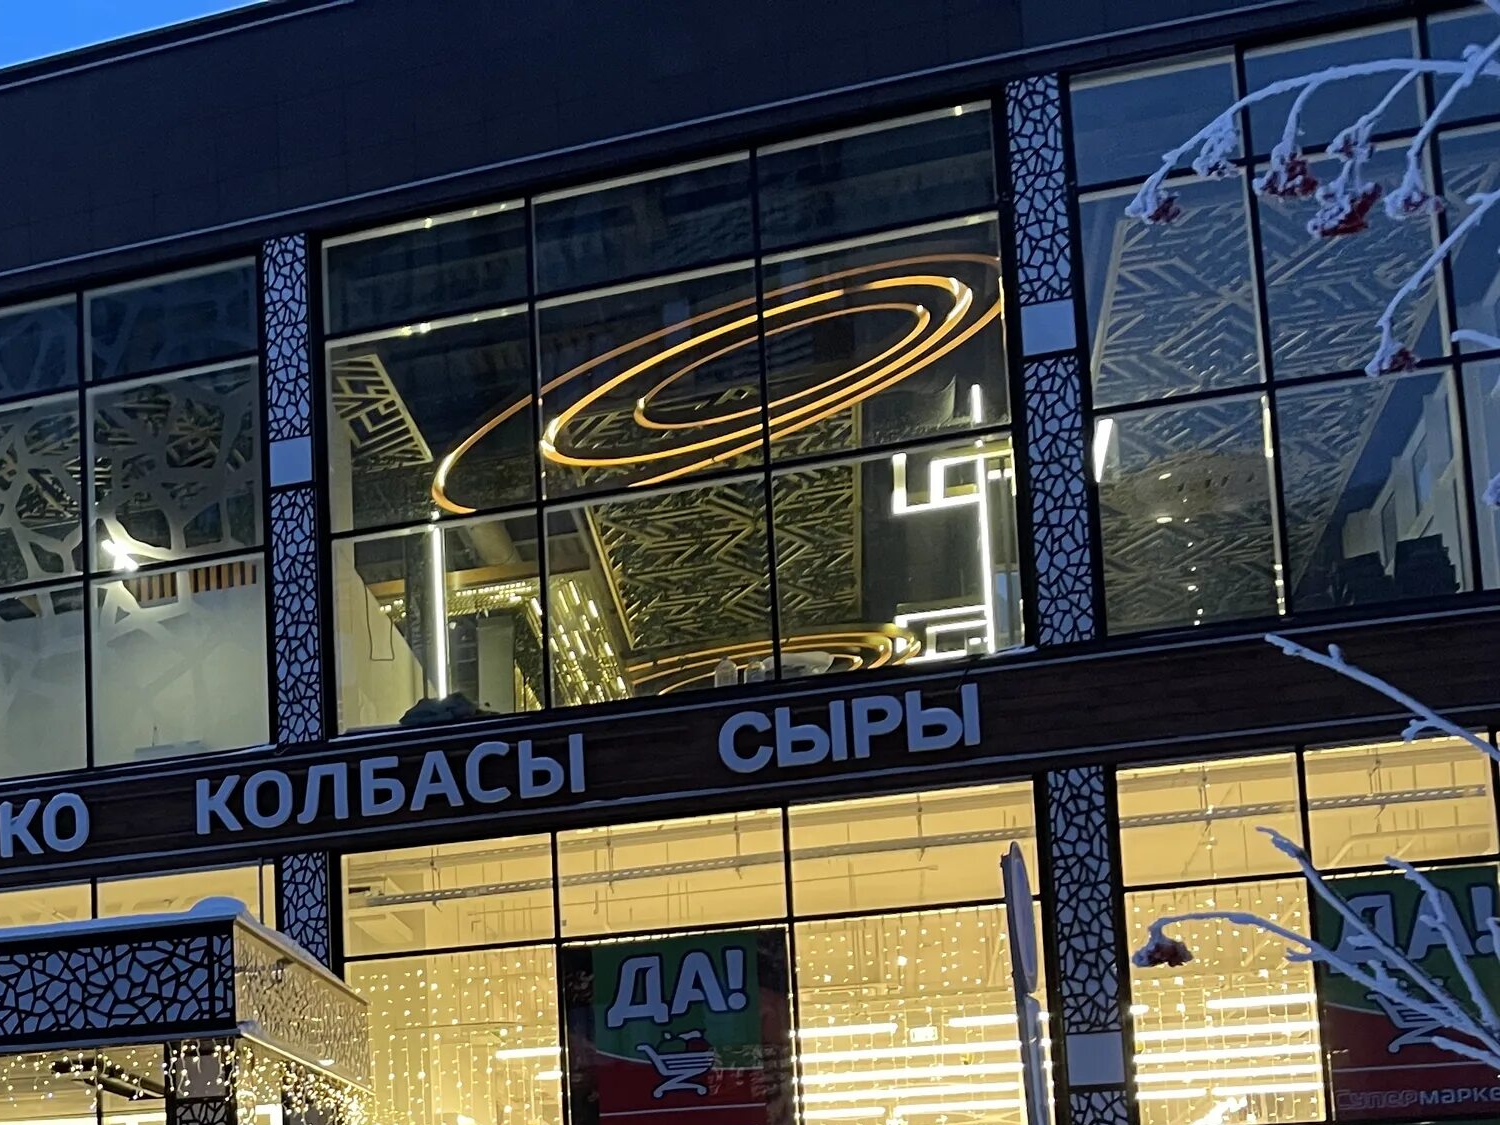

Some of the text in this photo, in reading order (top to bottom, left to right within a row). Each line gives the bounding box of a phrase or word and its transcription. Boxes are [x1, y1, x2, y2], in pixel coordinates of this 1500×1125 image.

[196, 734, 585, 835] КОЛБАСЫ
[718, 683, 981, 773] СЫРЫ
[1330, 886, 1496, 974] ДА!
[608, 949, 747, 1027] ДА!
